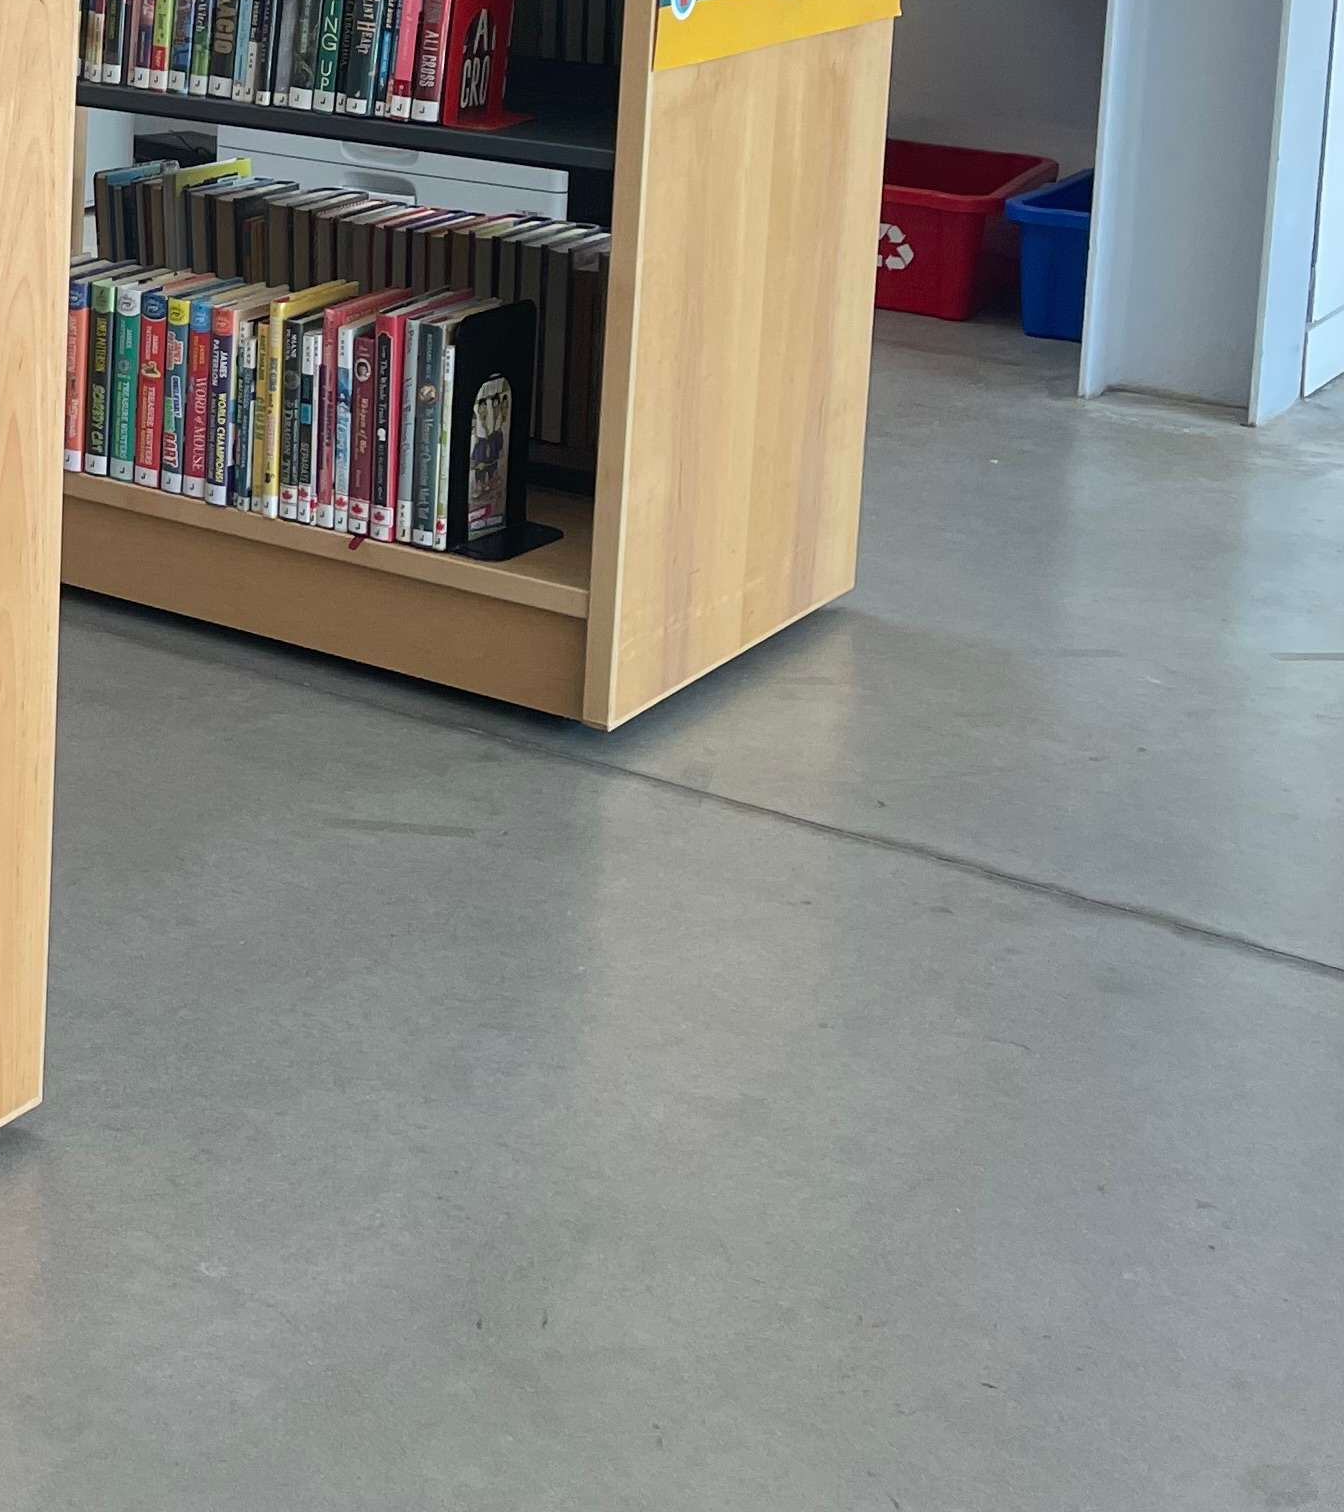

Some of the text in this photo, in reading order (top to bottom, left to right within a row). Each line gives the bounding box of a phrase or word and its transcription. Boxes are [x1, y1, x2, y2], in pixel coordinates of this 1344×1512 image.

[320, 60, 332, 91] UP
[419, 29, 440, 88] ALI CROSS
[460, 55, 490, 109] CRO
[212, 339, 220, 387] PATTERSON
[219, 350, 229, 379] JAMES
[191, 377, 208, 472] WORD MOUSE
